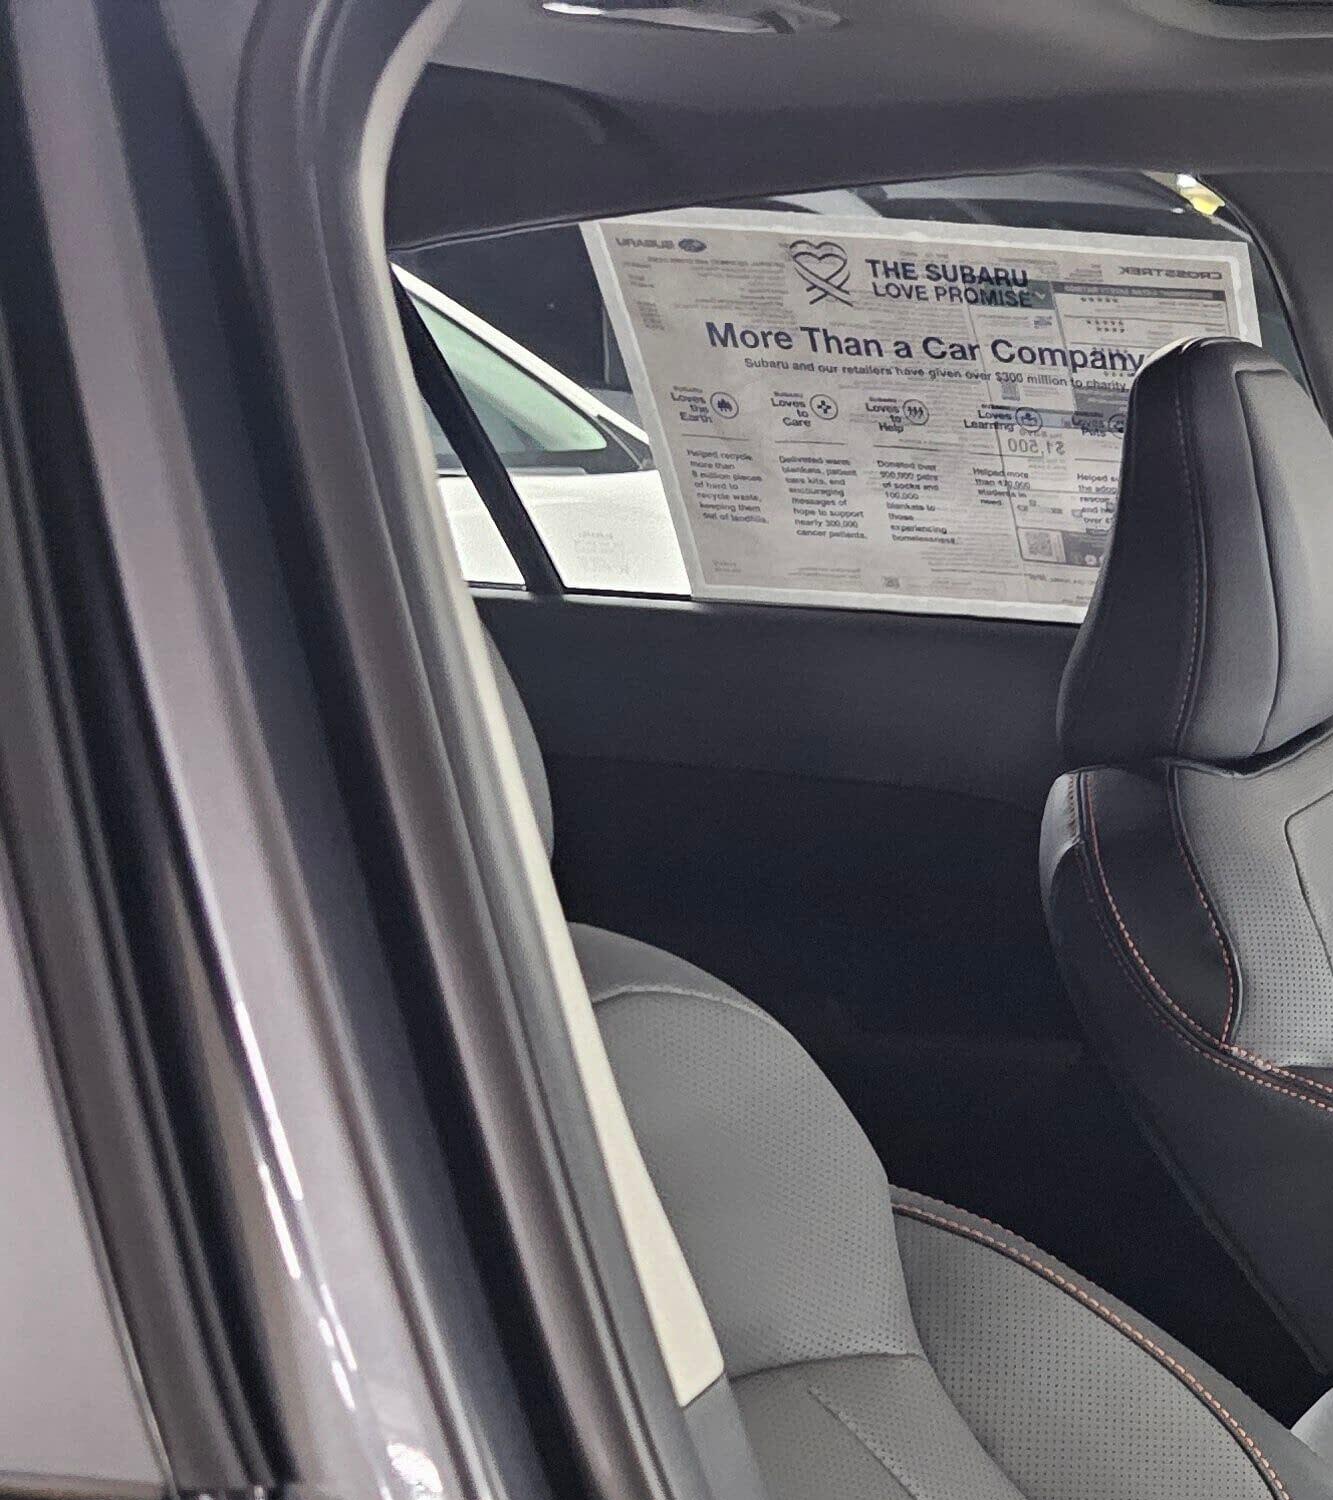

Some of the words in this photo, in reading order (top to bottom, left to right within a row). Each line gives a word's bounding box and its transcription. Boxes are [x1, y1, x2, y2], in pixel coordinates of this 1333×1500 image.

[866, 259, 918, 280] THE
[926, 264, 1028, 288] SUBARU
[873, 282, 929, 302] LOVE
[934, 286, 1033, 308] PROMISE
[705, 322, 794, 350] More
[800, 326, 884, 357] Than
[893, 338, 914, 359] a
[922, 336, 979, 361] Car
[991, 339, 1145, 373] Company
[745, 357, 789, 371] Subaru
[792, 361, 815, 372] and
[818, 364, 838, 374] our
[894, 366, 925, 378] have
[929, 368, 962, 382] given
[965, 371, 992, 382] over
[994, 371, 1023, 384] $300
[1027, 373, 1069, 388] million
[1071, 377, 1084, 389] to
[771, 398, 806, 408] Loves
[865, 403, 900, 414] Loves
[680, 412, 713, 423] Earth
[977, 409, 1012, 420] Loves
[782, 417, 811, 427] Care
[878, 422, 904, 433] Help
[963, 419, 1015, 432] Learning
[793, 507, 816, 516] hope
[829, 510, 864, 519] support
[795, 518, 823, 528] nearly
[796, 528, 826, 536] cancer
